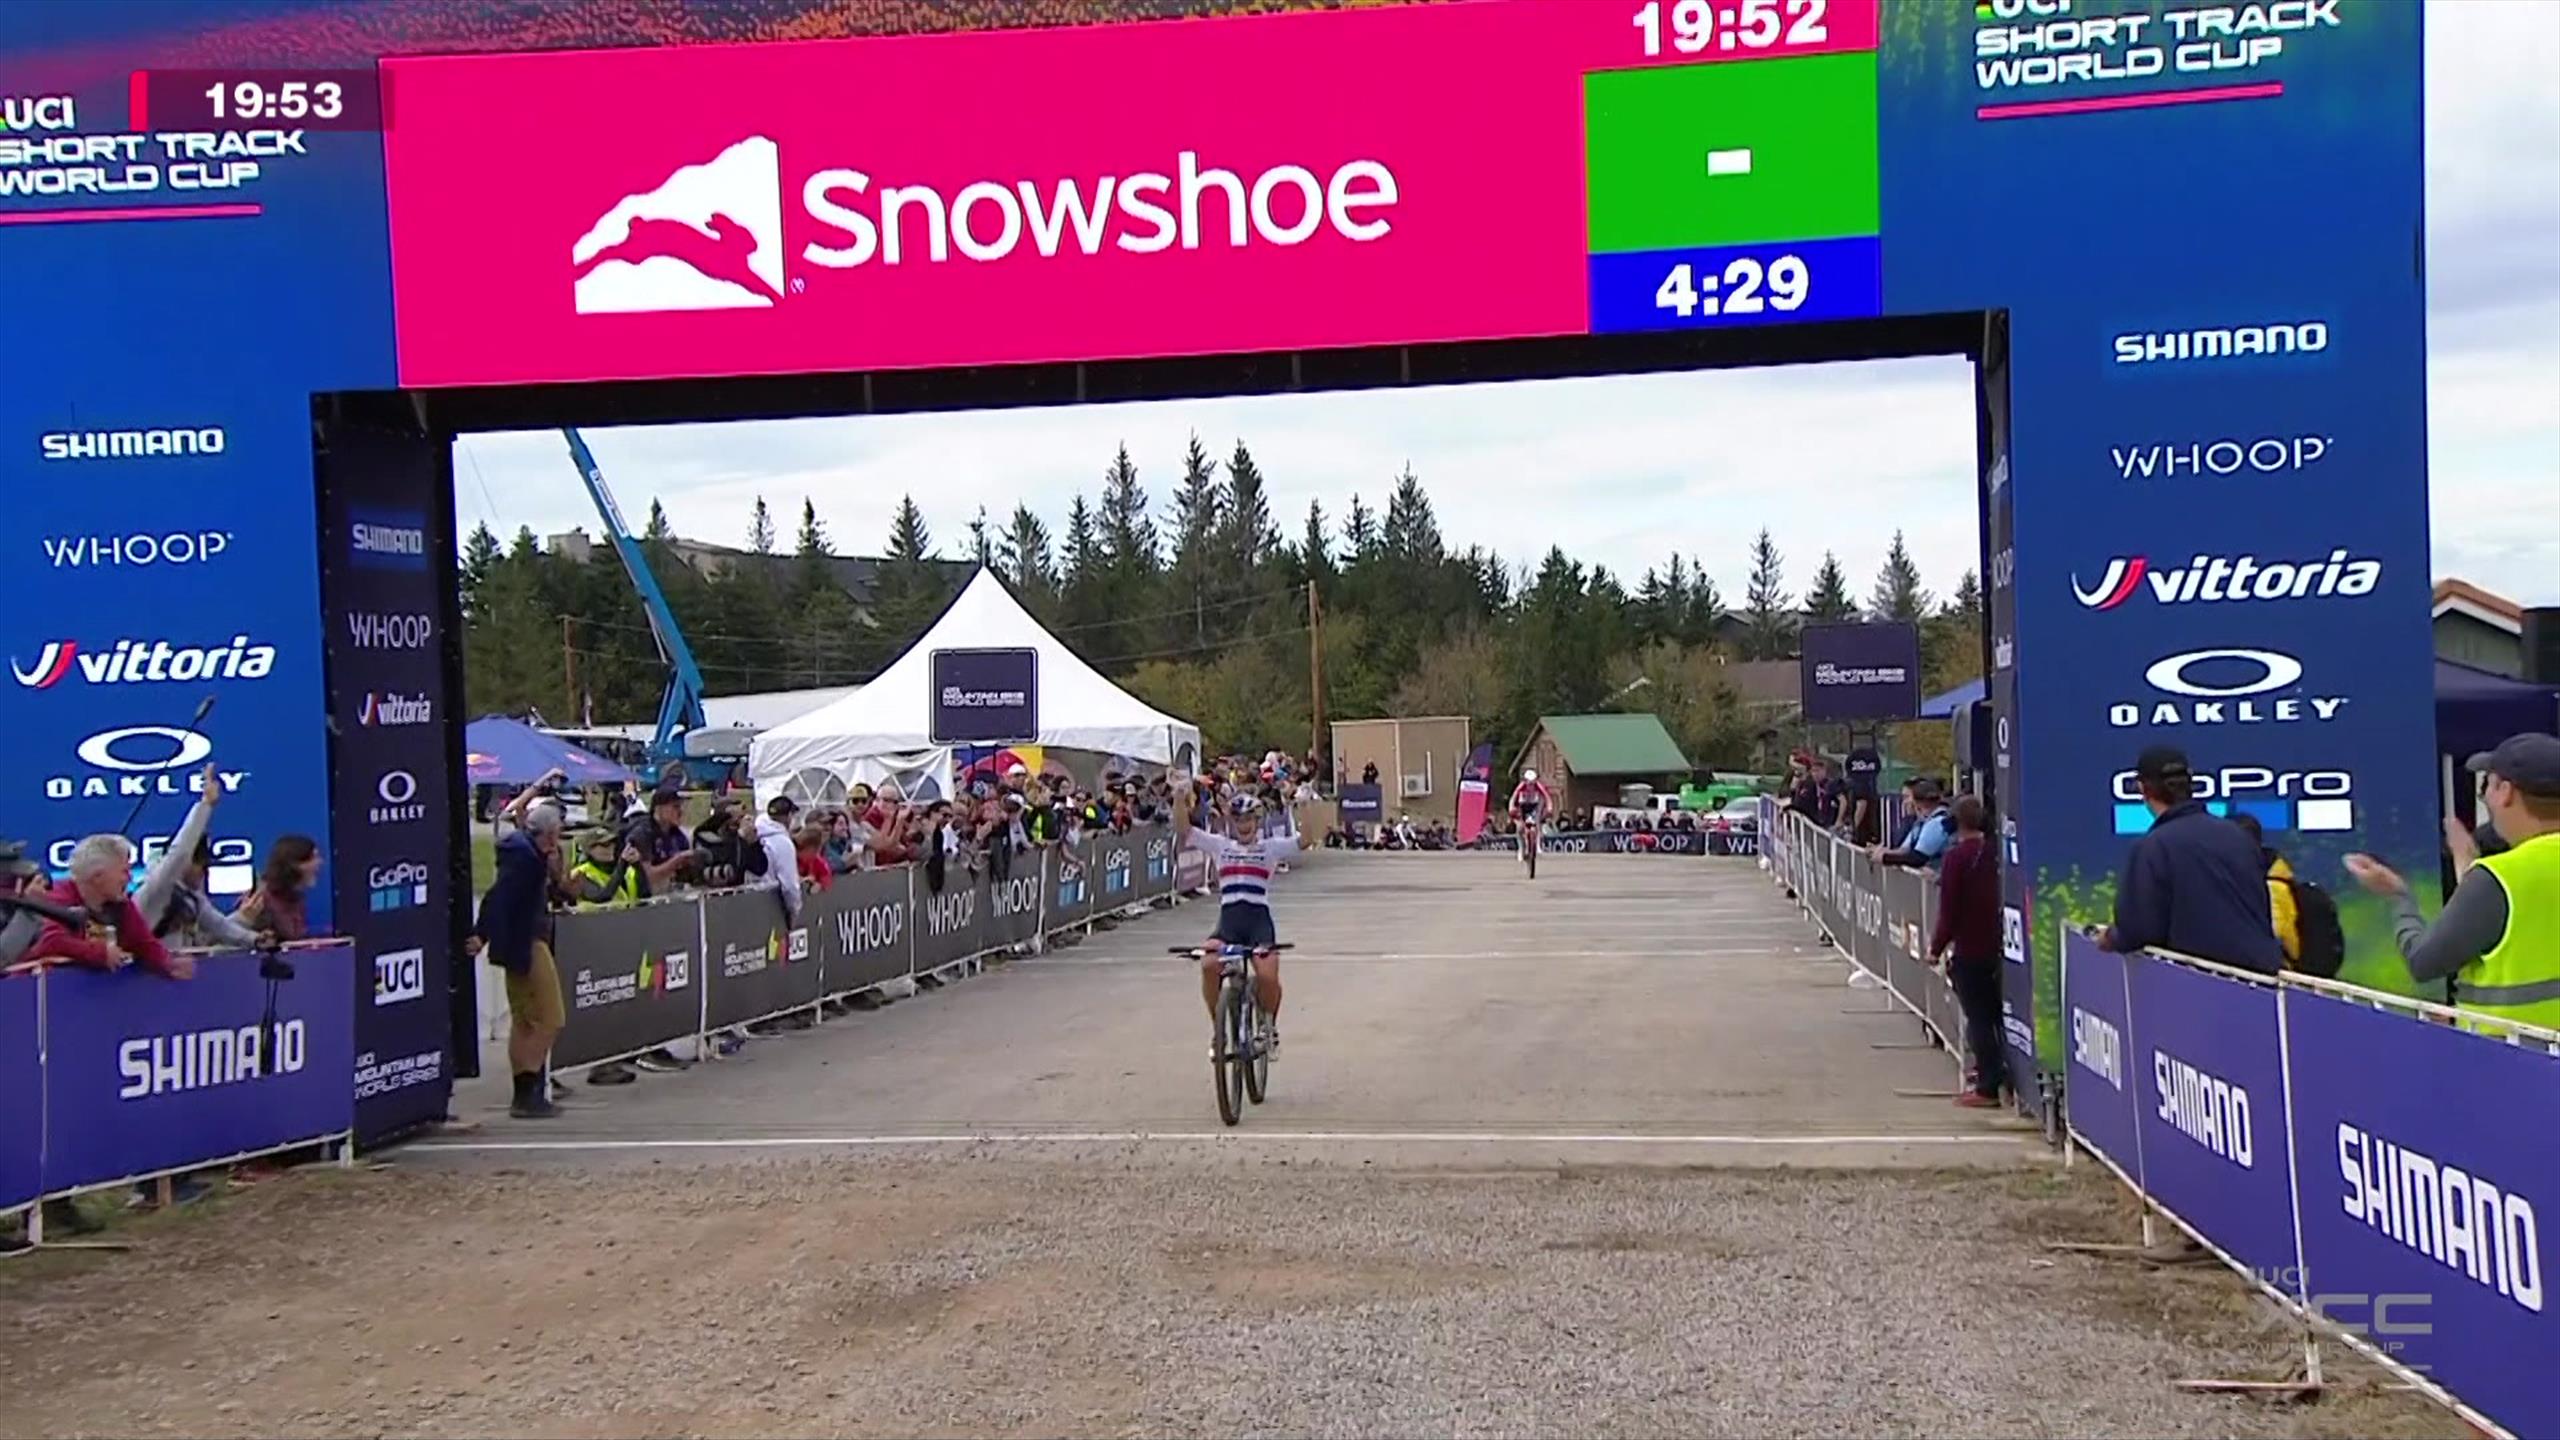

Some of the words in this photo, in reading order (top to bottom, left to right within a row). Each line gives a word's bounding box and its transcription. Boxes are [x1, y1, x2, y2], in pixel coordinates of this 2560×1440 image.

[1633, 0, 1827, 55] 19:52
[1975, 16, 2149, 56] SHORT
[2164, 0, 2341, 40] TRACK
[1976, 48, 2164, 88] WORLD
[2175, 36, 2283, 72] CUP
[4, 96, 75, 131] UCI
[0, 134, 146, 165] SHORT
[156, 129, 306, 159] TRACK
[0, 164, 160, 196] WORLD
[169, 161, 260, 189] CUP
[802, 150, 1399, 269] Snowshoe
[1656, 254, 1810, 317] 4:29
[2115, 323, 2327, 363] SHIMANO
[42, 429, 224, 459] SHIMANO
[2112, 436, 2326, 478] WHOOP
[43, 532, 227, 567] WHOOP
[352, 523, 423, 555] SHIMANO
[2146, 549, 2382, 603] vittoria
[348, 612, 431, 649] WHOOP
[76, 636, 276, 684] vittoria
[376, 692, 431, 725] vittoria
[2110, 697, 2340, 727] OAKLEY
[46, 772, 244, 799] OAKLEY
[369, 804, 426, 825] OAKLEY
[369, 862, 428, 889] GoPro
[926, 888, 976, 937] WHOOP
[991, 876, 1038, 918] WHOOP
[837, 902, 903, 955] WHOOP
[385, 958, 419, 993] UCI
[2153, 1048, 2253, 1170] SHIMANO
[2337, 1121, 2543, 1314] SHIMANO
